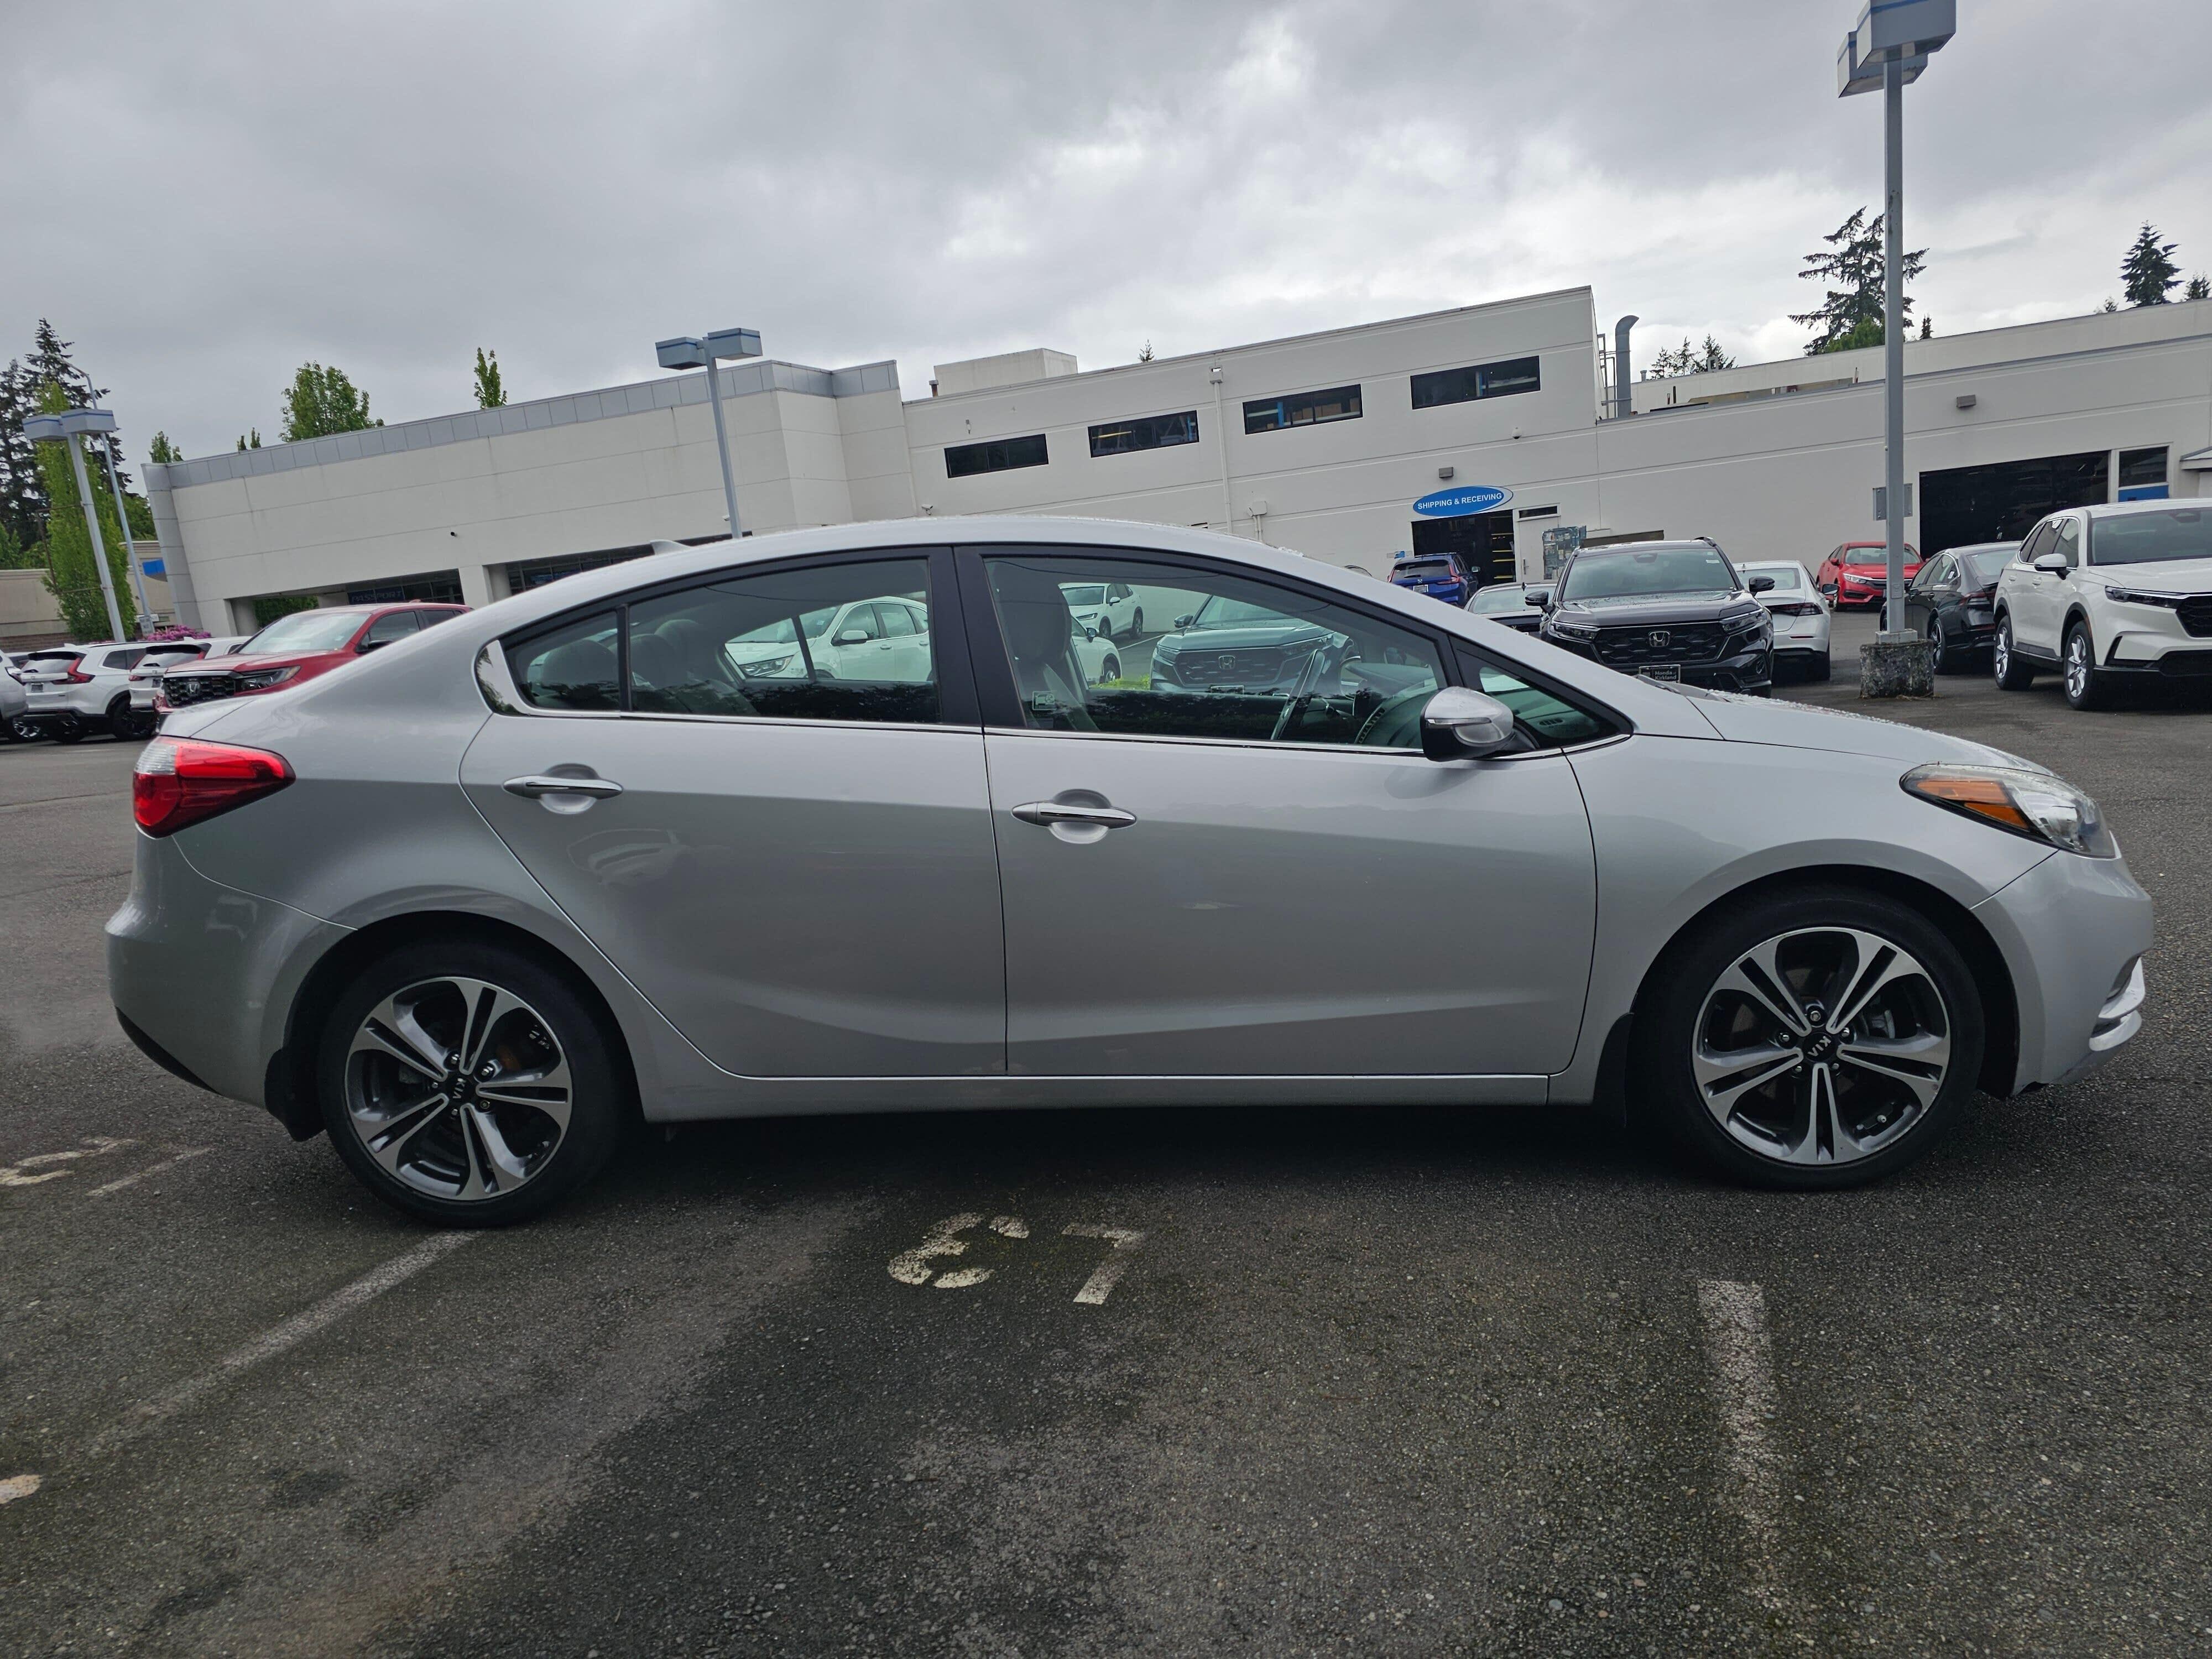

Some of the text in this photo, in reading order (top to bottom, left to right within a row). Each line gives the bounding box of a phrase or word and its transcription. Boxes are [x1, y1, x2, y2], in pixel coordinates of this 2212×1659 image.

[1418, 499, 1452, 509] SHIPPING
[1461, 493, 1502, 504] RECEIVING
[1807, 1036, 1832, 1057] KIA
[452, 1078, 467, 1099] KIA
